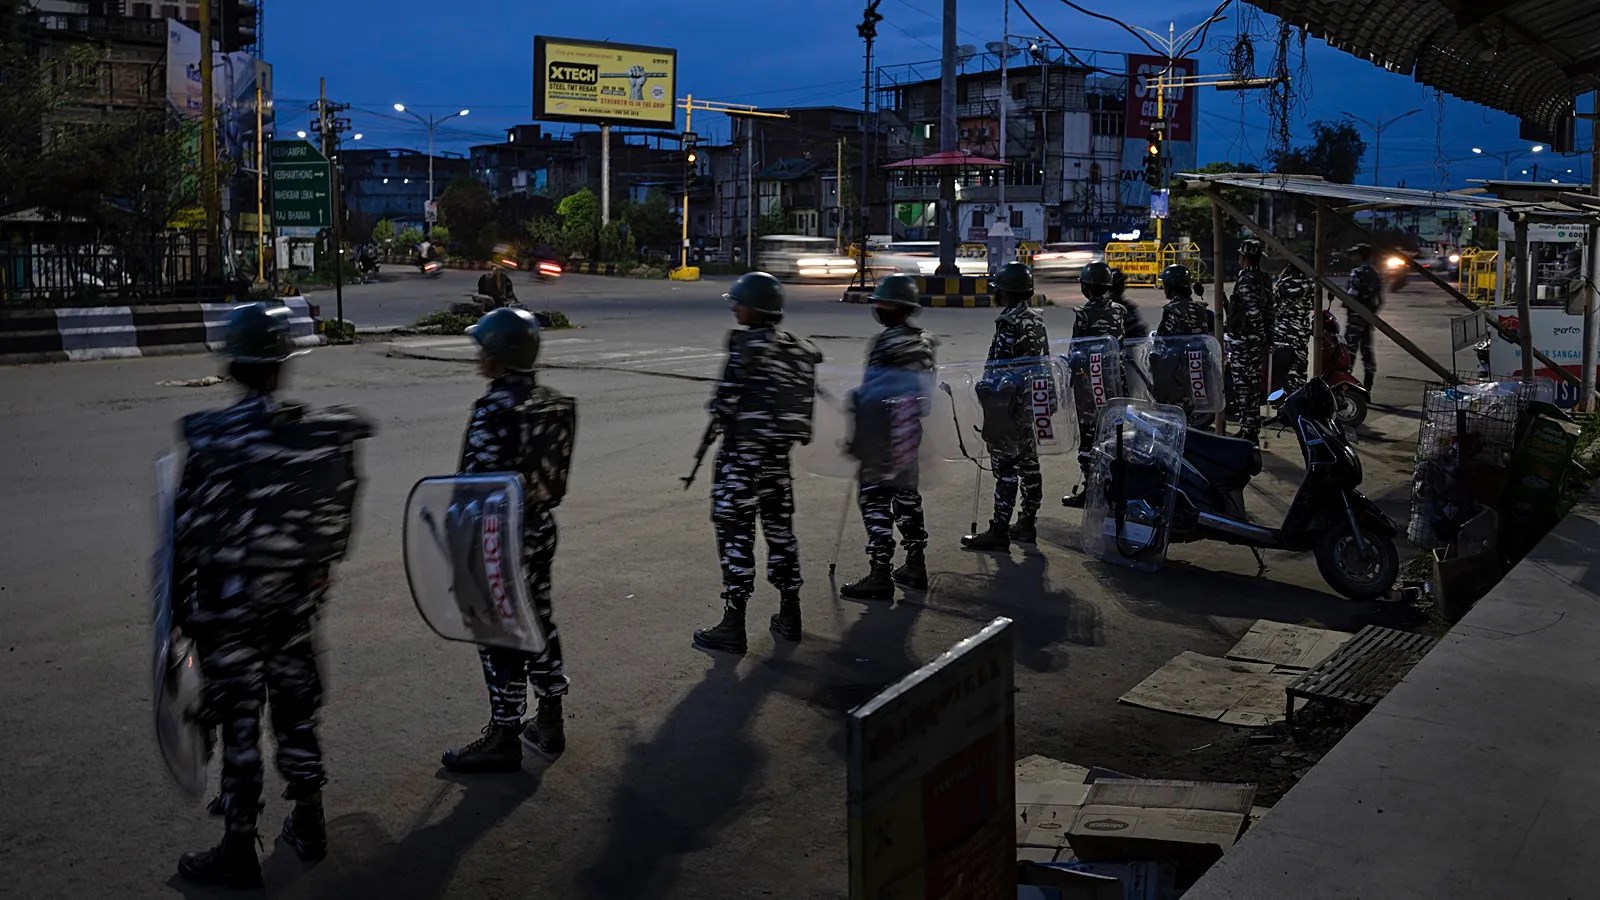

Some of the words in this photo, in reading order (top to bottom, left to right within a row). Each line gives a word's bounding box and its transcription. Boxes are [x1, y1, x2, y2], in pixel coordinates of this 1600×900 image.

[550, 66, 596, 82] XTECH
[549, 82, 566, 91] STEEL
[600, 97, 627, 105] STRENGTH
[1141, 100, 1178, 118] CENT
[275, 210, 286, 220] RAJ
[287, 211, 311, 220] BHAWAN
[1553, 349, 1581, 358] SANGAI
[1090, 353, 1105, 407] POLICE
[1189, 352, 1207, 399] POLICE
[1033, 380, 1053, 439] POLICE
[484, 517, 513, 618] POLICE
